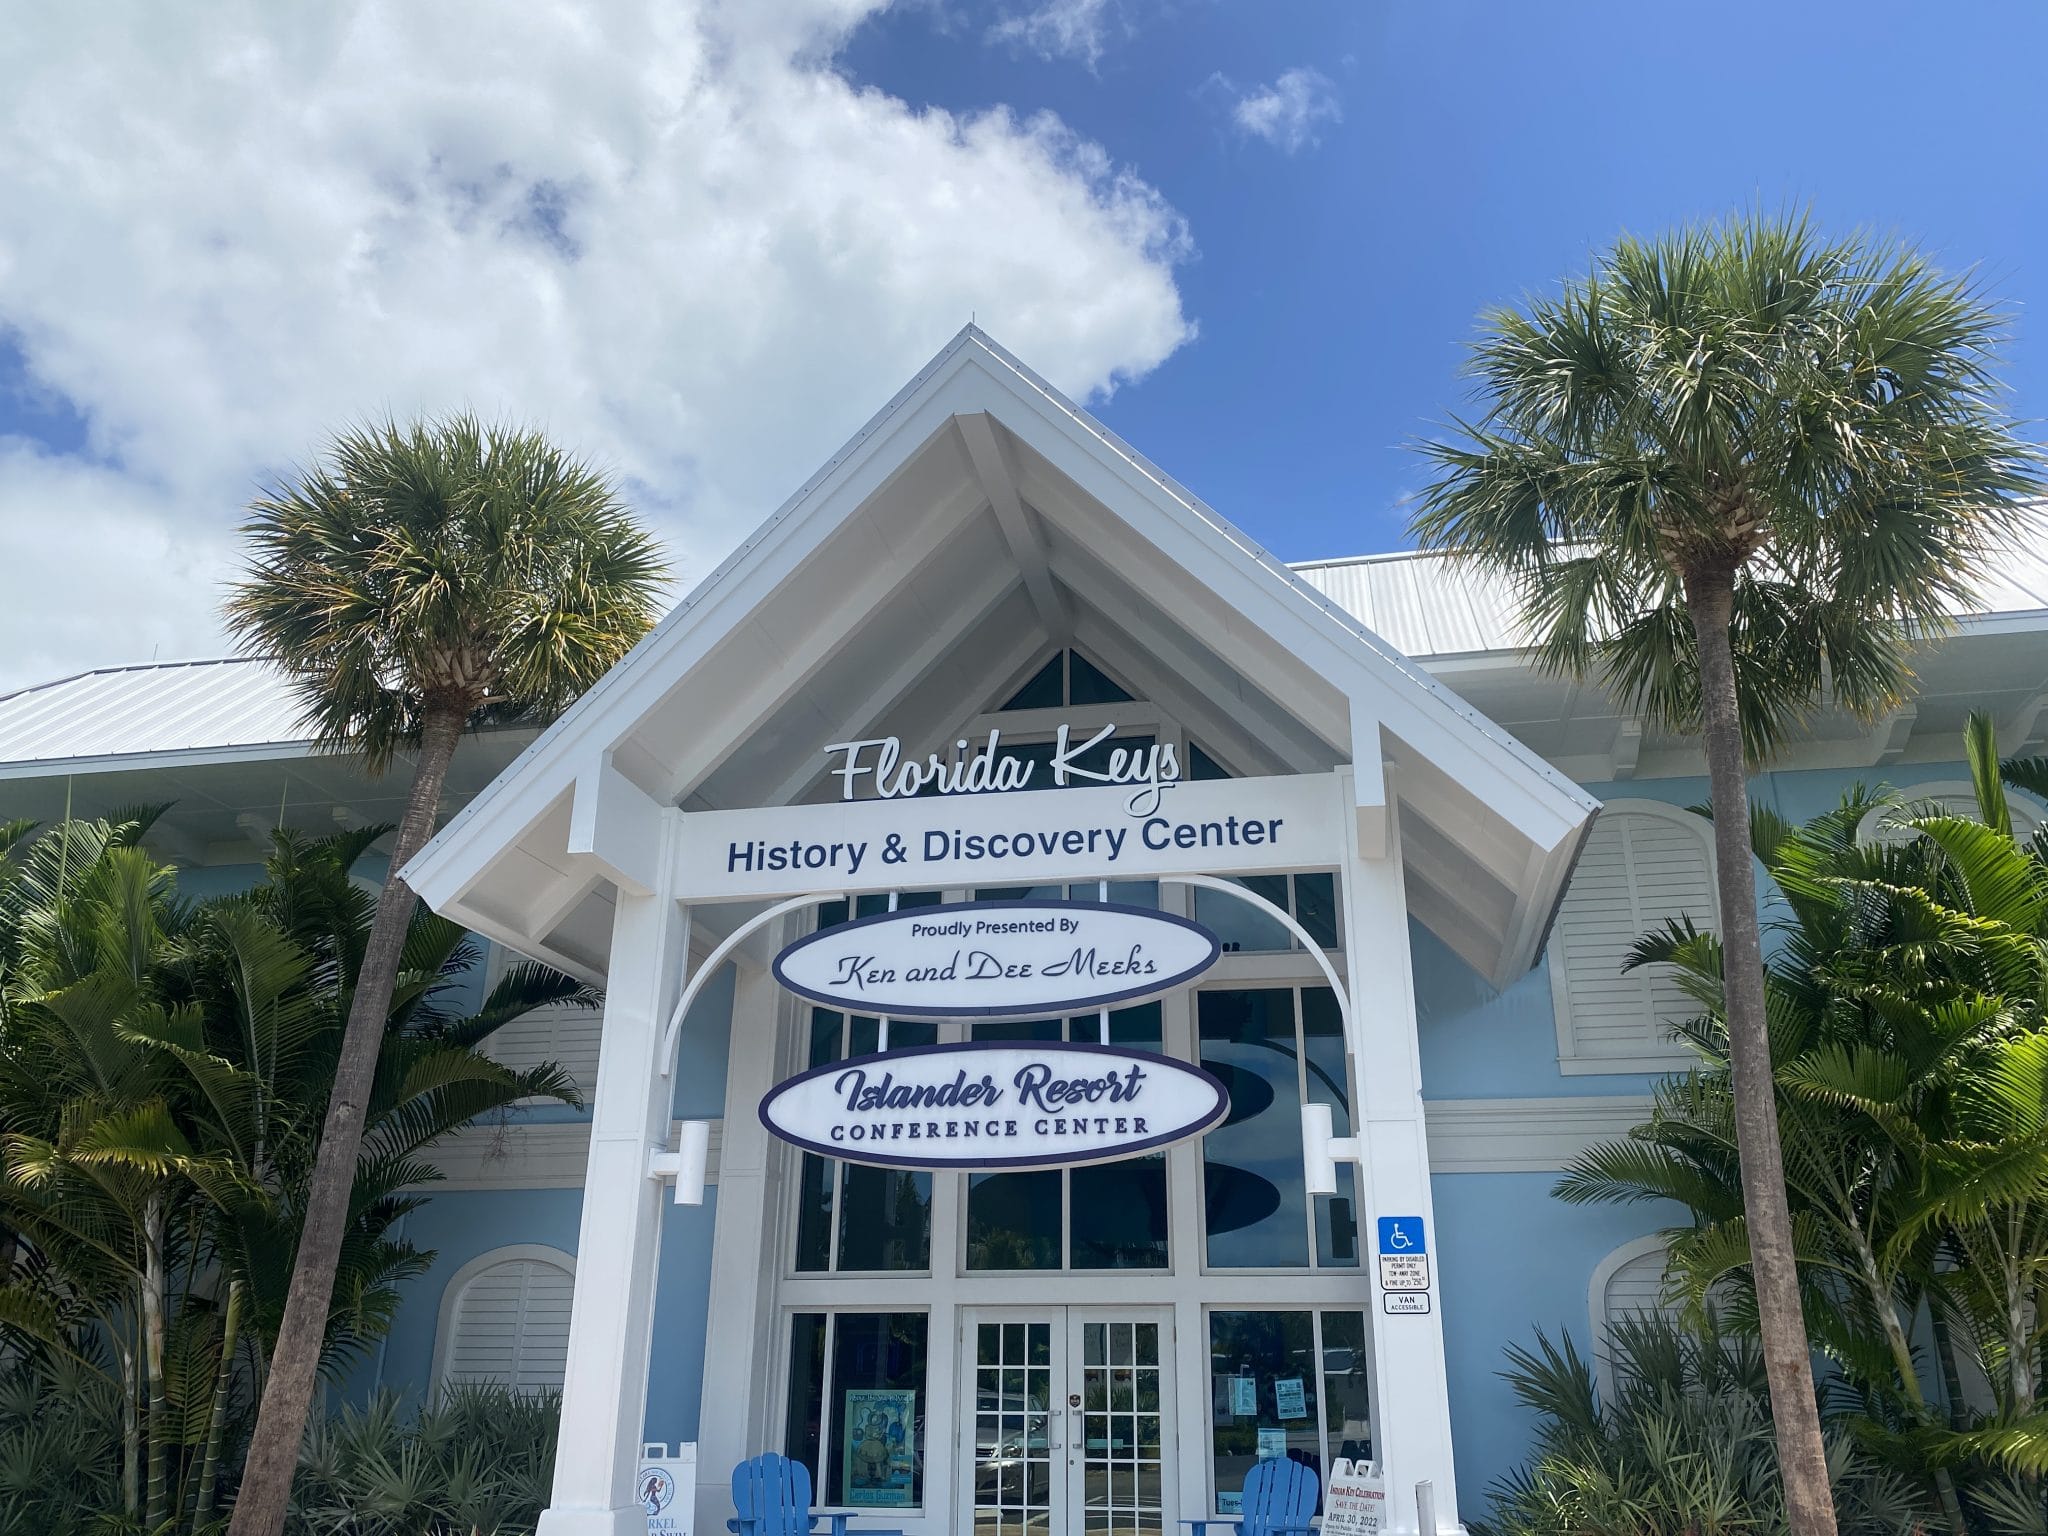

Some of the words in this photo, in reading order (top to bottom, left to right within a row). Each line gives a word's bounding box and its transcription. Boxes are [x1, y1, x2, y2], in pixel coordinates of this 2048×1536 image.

[823, 728, 1034, 801] Florida
[1049, 724, 1181, 818] Keys
[727, 840, 868, 875] History
[880, 834, 908, 864] &
[922, 823, 1127, 862] Discovery
[1141, 814, 1284, 852] Center
[911, 921, 972, 938] Proudly
[976, 918, 1055, 935] Presented
[1060, 917, 1079, 934] By
[828, 955, 897, 990] Ken
[904, 949, 961, 982] and
[964, 950, 1033, 980] Dee
[1041, 943, 1158, 978] Meeks
[834, 1063, 1004, 1112] Islander
[1013, 1062, 1147, 1114] Resort
[830, 1119, 1018, 1141] CONFERENCE
[1035, 1117, 1149, 1137] CENTER
[648, 1518, 677, 1529] RKEL
[1328, 1512, 1345, 1523] APRIL
[1347, 1514, 1358, 1525] 30,
[1360, 1516, 1378, 1527] 2022
